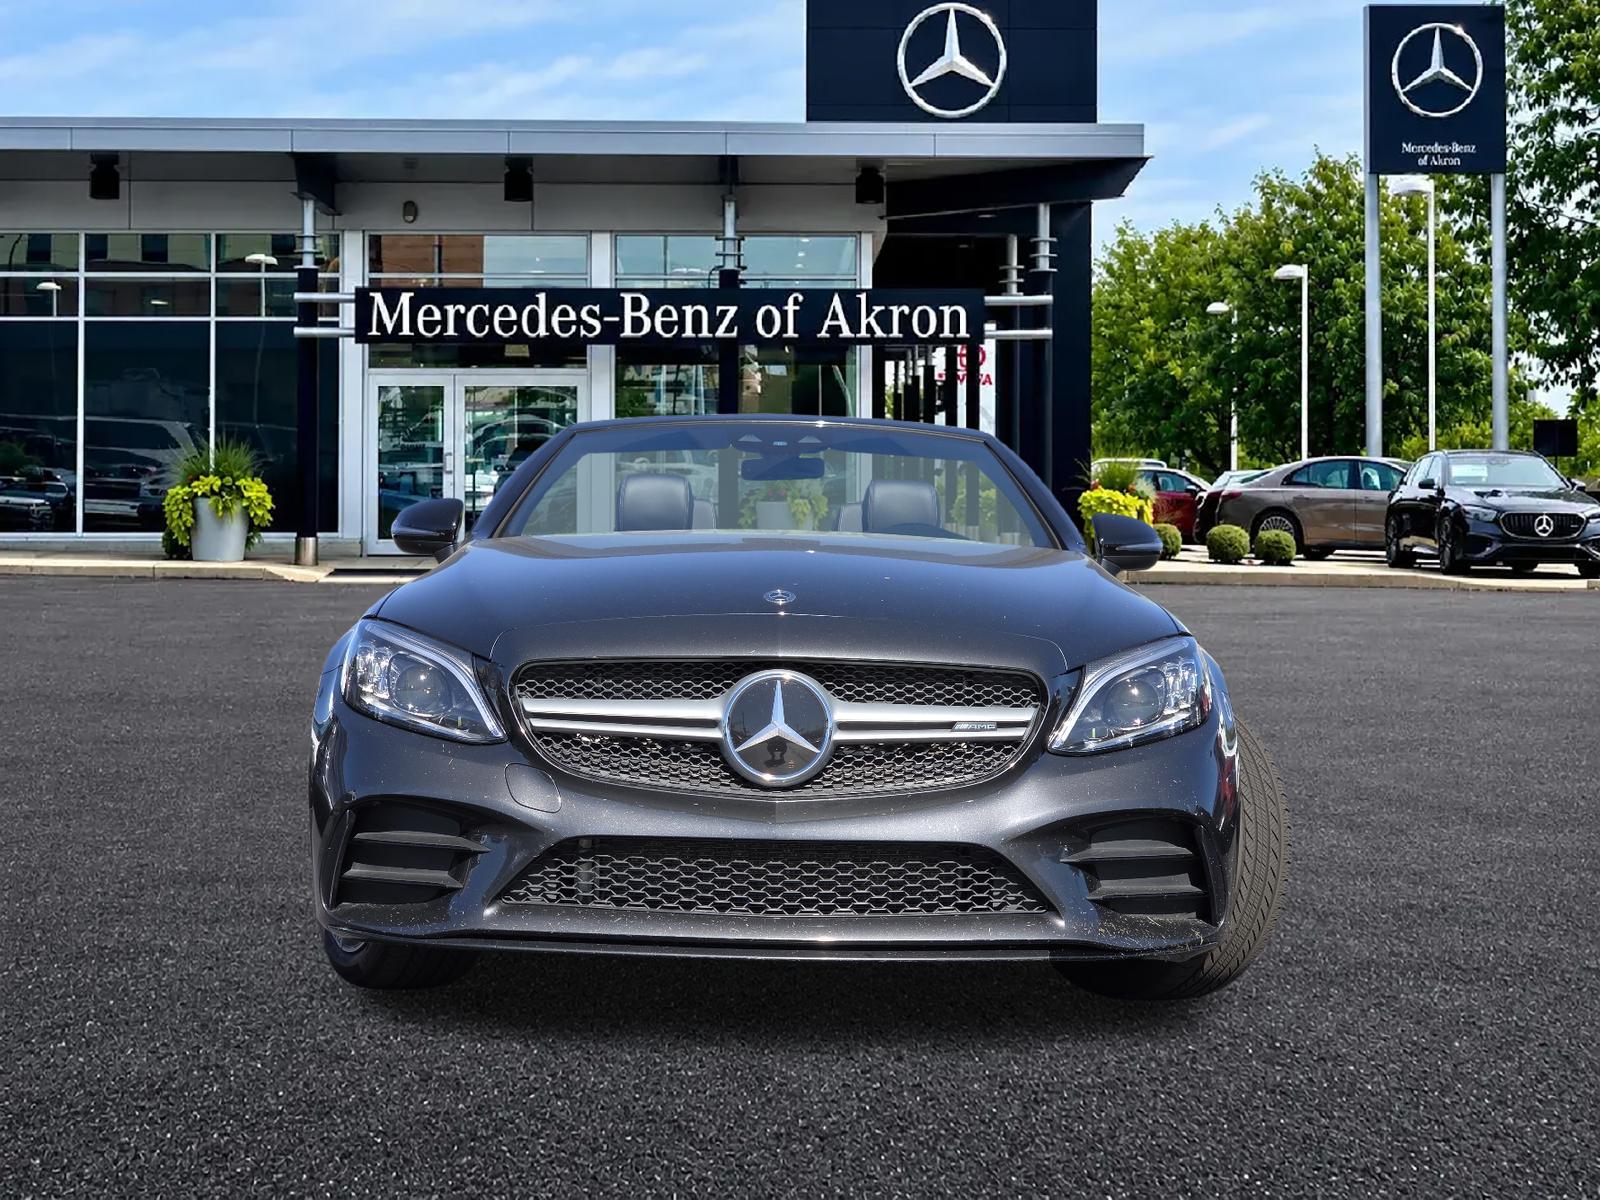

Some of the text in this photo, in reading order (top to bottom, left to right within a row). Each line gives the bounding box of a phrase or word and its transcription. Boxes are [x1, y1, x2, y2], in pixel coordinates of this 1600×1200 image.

[1401, 142, 1476, 153] Mercedes-Benz
[1417, 155, 1461, 165] of Akron
[367, 291, 970, 338] Mercedes-Benz of Akron
